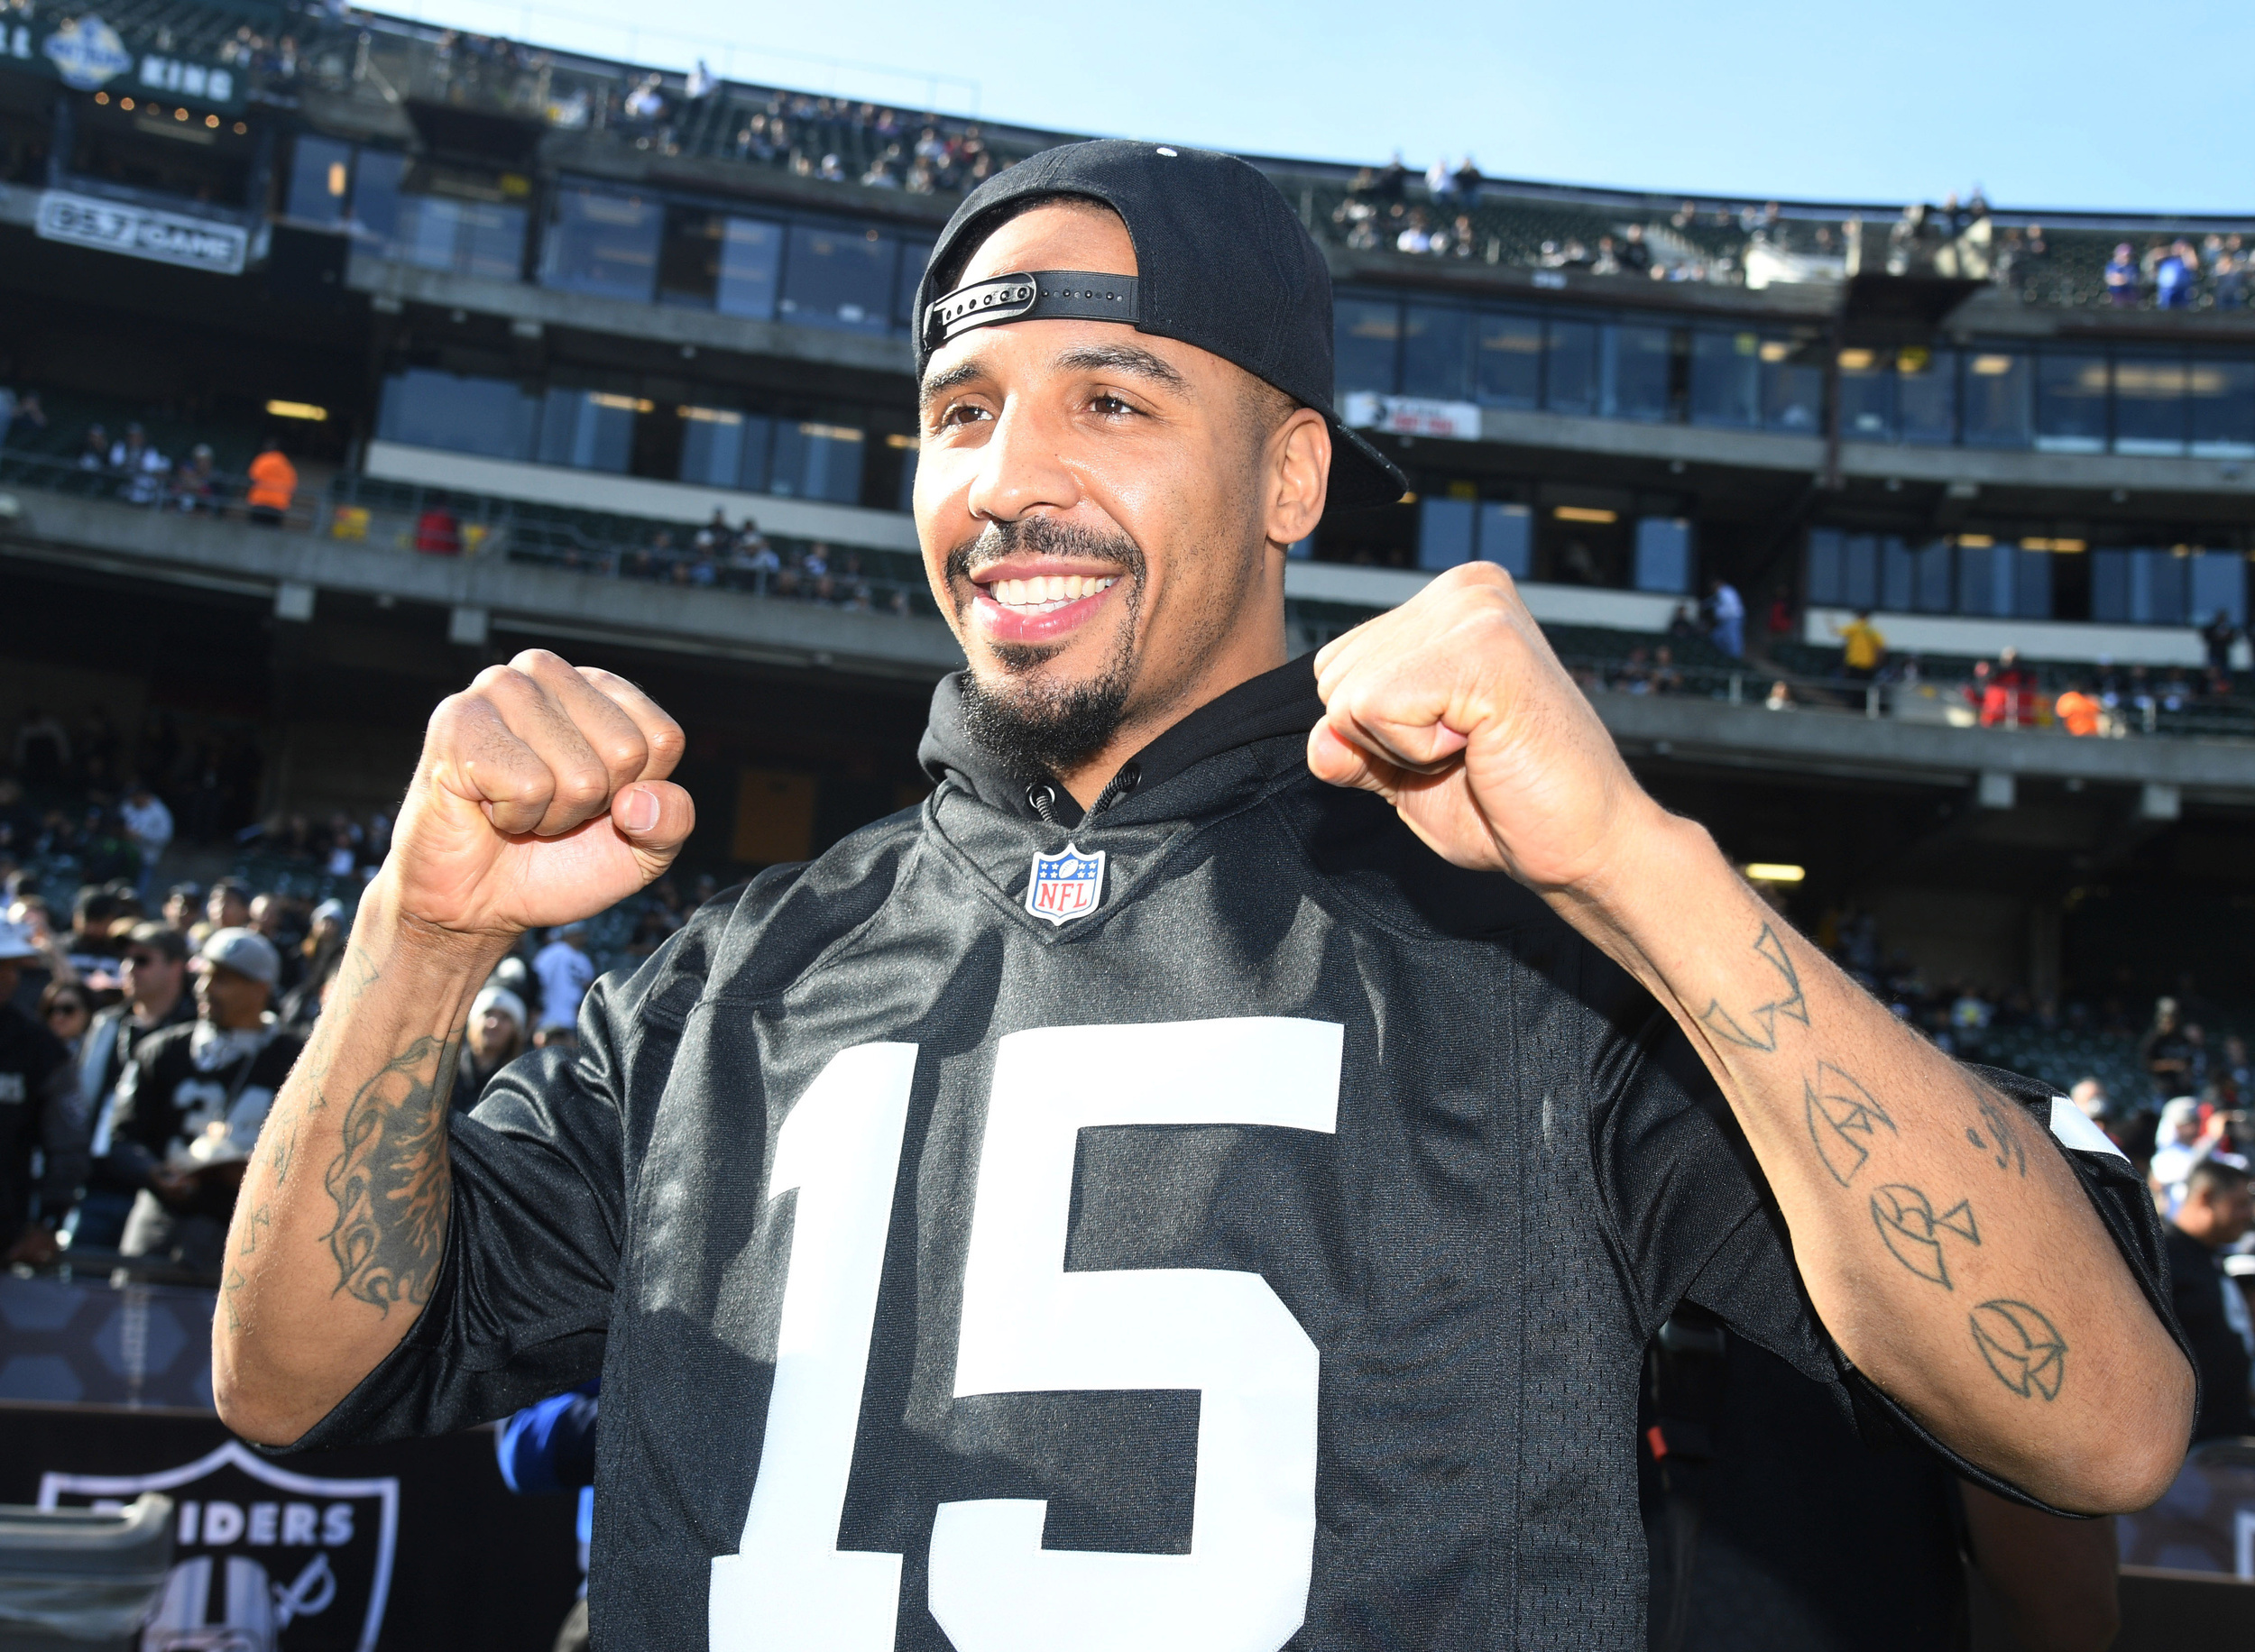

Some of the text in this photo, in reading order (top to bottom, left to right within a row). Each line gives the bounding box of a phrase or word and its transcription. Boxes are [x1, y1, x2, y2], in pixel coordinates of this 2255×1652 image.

[1038, 883, 1087, 912] NFL
[708, 1016, 1344, 1652] 15
[93, 1500, 355, 1546] IDERS
